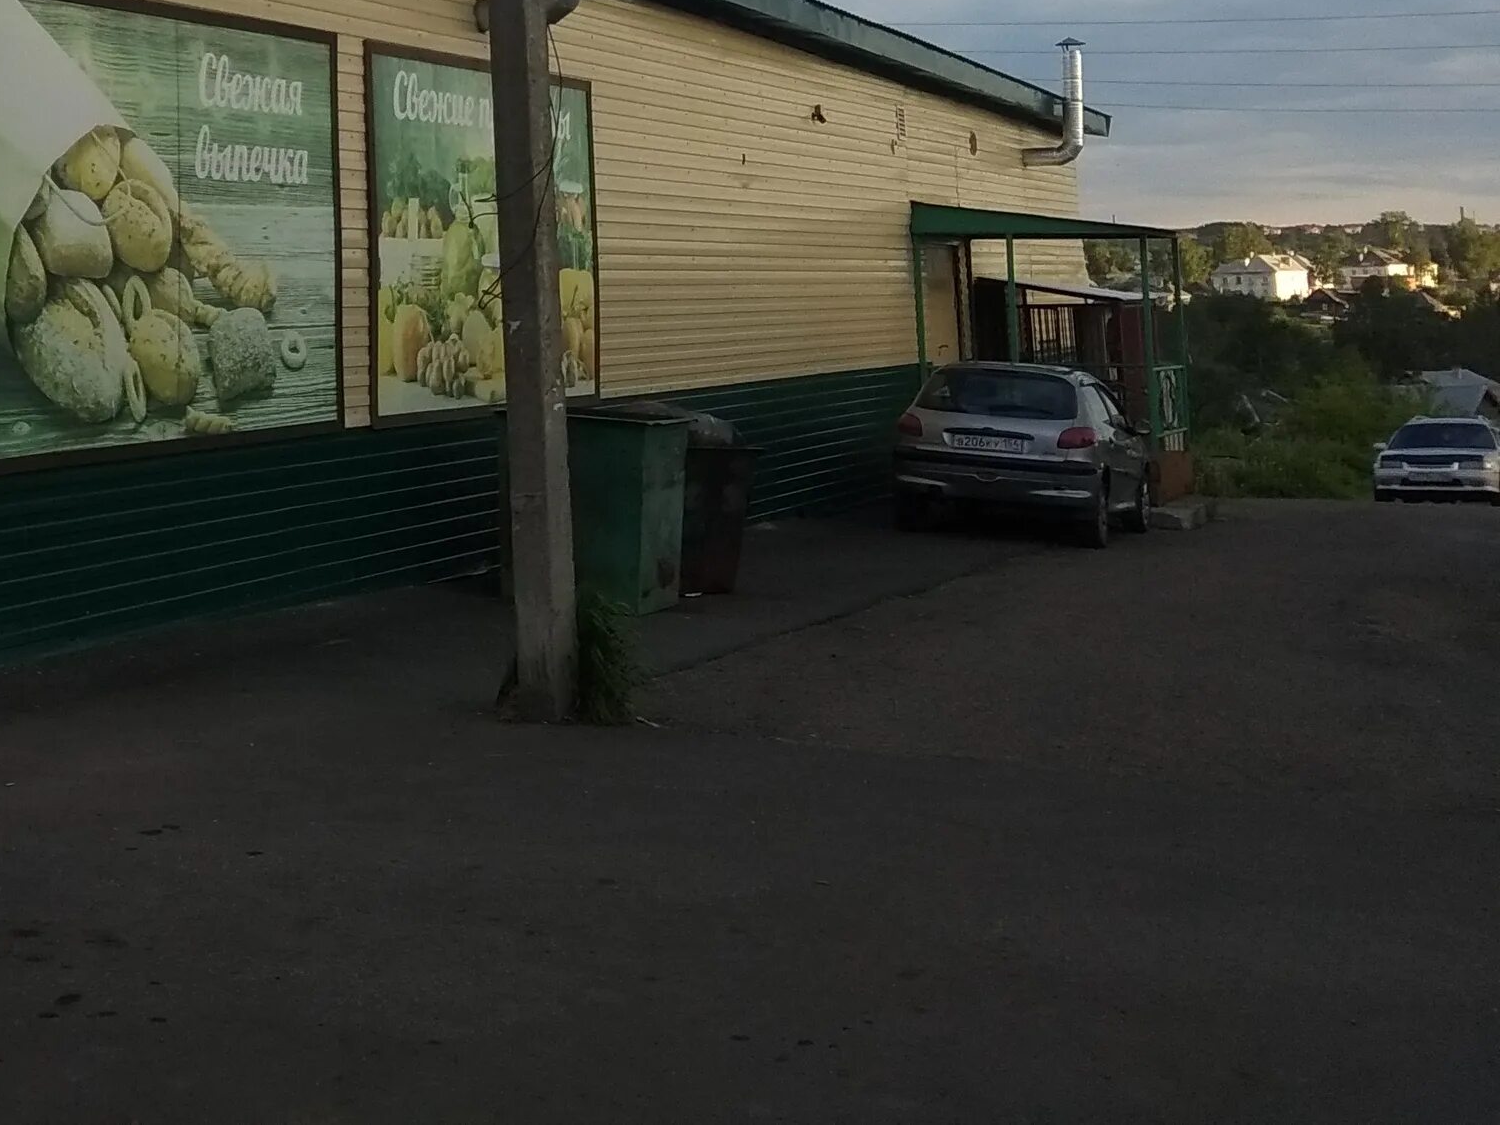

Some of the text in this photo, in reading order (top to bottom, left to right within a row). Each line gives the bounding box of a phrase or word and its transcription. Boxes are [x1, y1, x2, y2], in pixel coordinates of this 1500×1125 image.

[198, 52, 303, 116] Свежая
[392, 69, 475, 127] Свежие
[194, 124, 309, 185] выпечка
